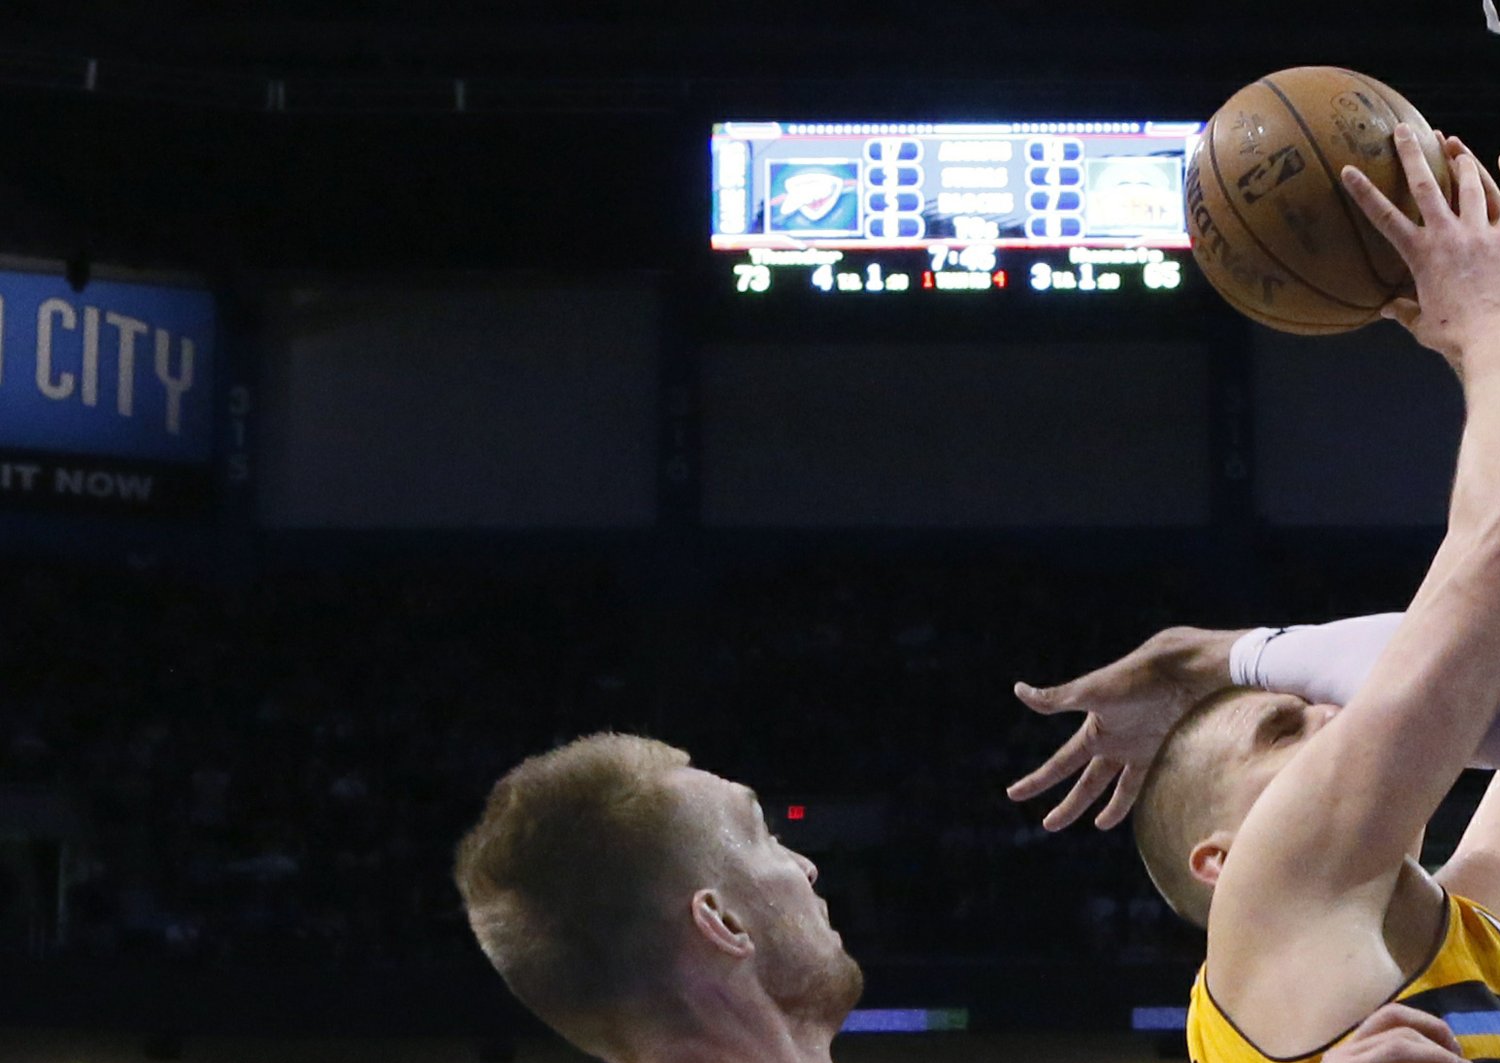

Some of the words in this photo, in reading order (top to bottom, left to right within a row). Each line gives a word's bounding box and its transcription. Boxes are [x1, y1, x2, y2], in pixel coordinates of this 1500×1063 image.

[734, 265, 770, 291] 73
[36, 297, 195, 435] CITY
[54, 466, 152, 499] NOW
